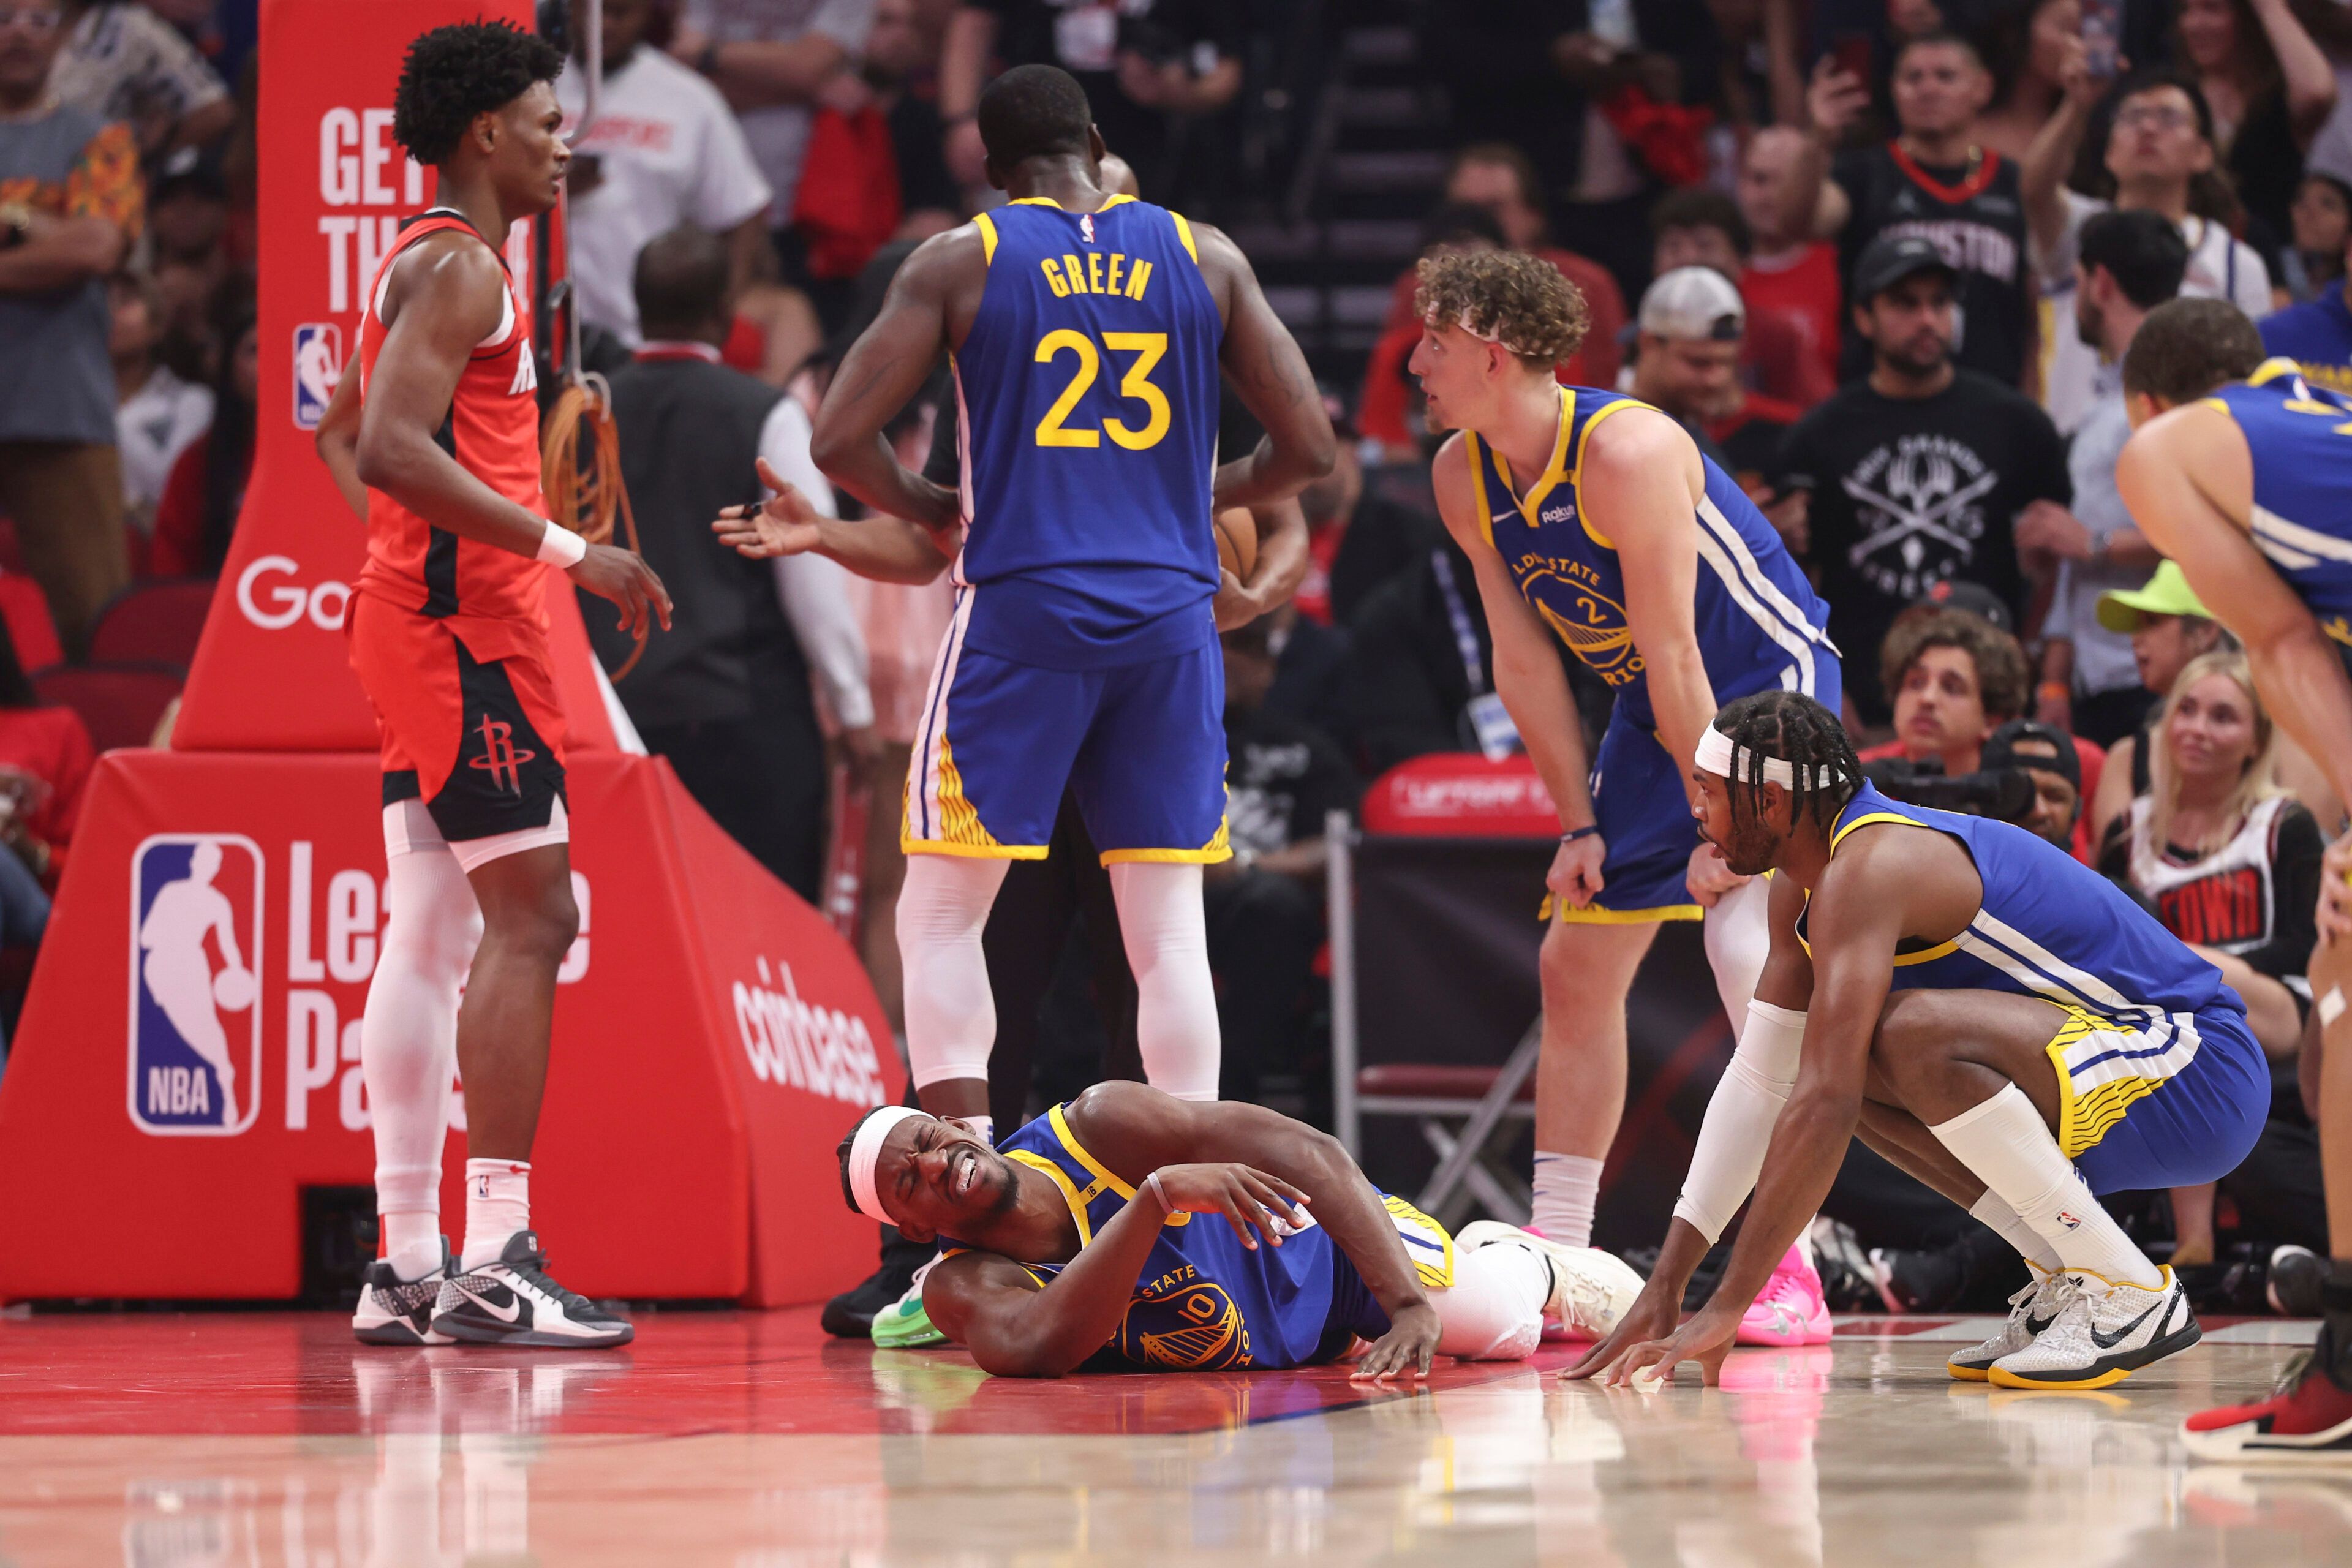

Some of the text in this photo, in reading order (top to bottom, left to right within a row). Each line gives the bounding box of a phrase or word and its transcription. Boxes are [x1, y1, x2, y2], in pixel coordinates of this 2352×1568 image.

[1041, 252, 1153, 301] GREEN
[1034, 328, 1172, 451] 23
[1547, 557, 1601, 587] STATE
[1576, 597, 1608, 624] 2
[148, 1066, 209, 1116] NBA
[1142, 1264, 1196, 1298] STATE
[1177, 1293, 1216, 1325] 10
